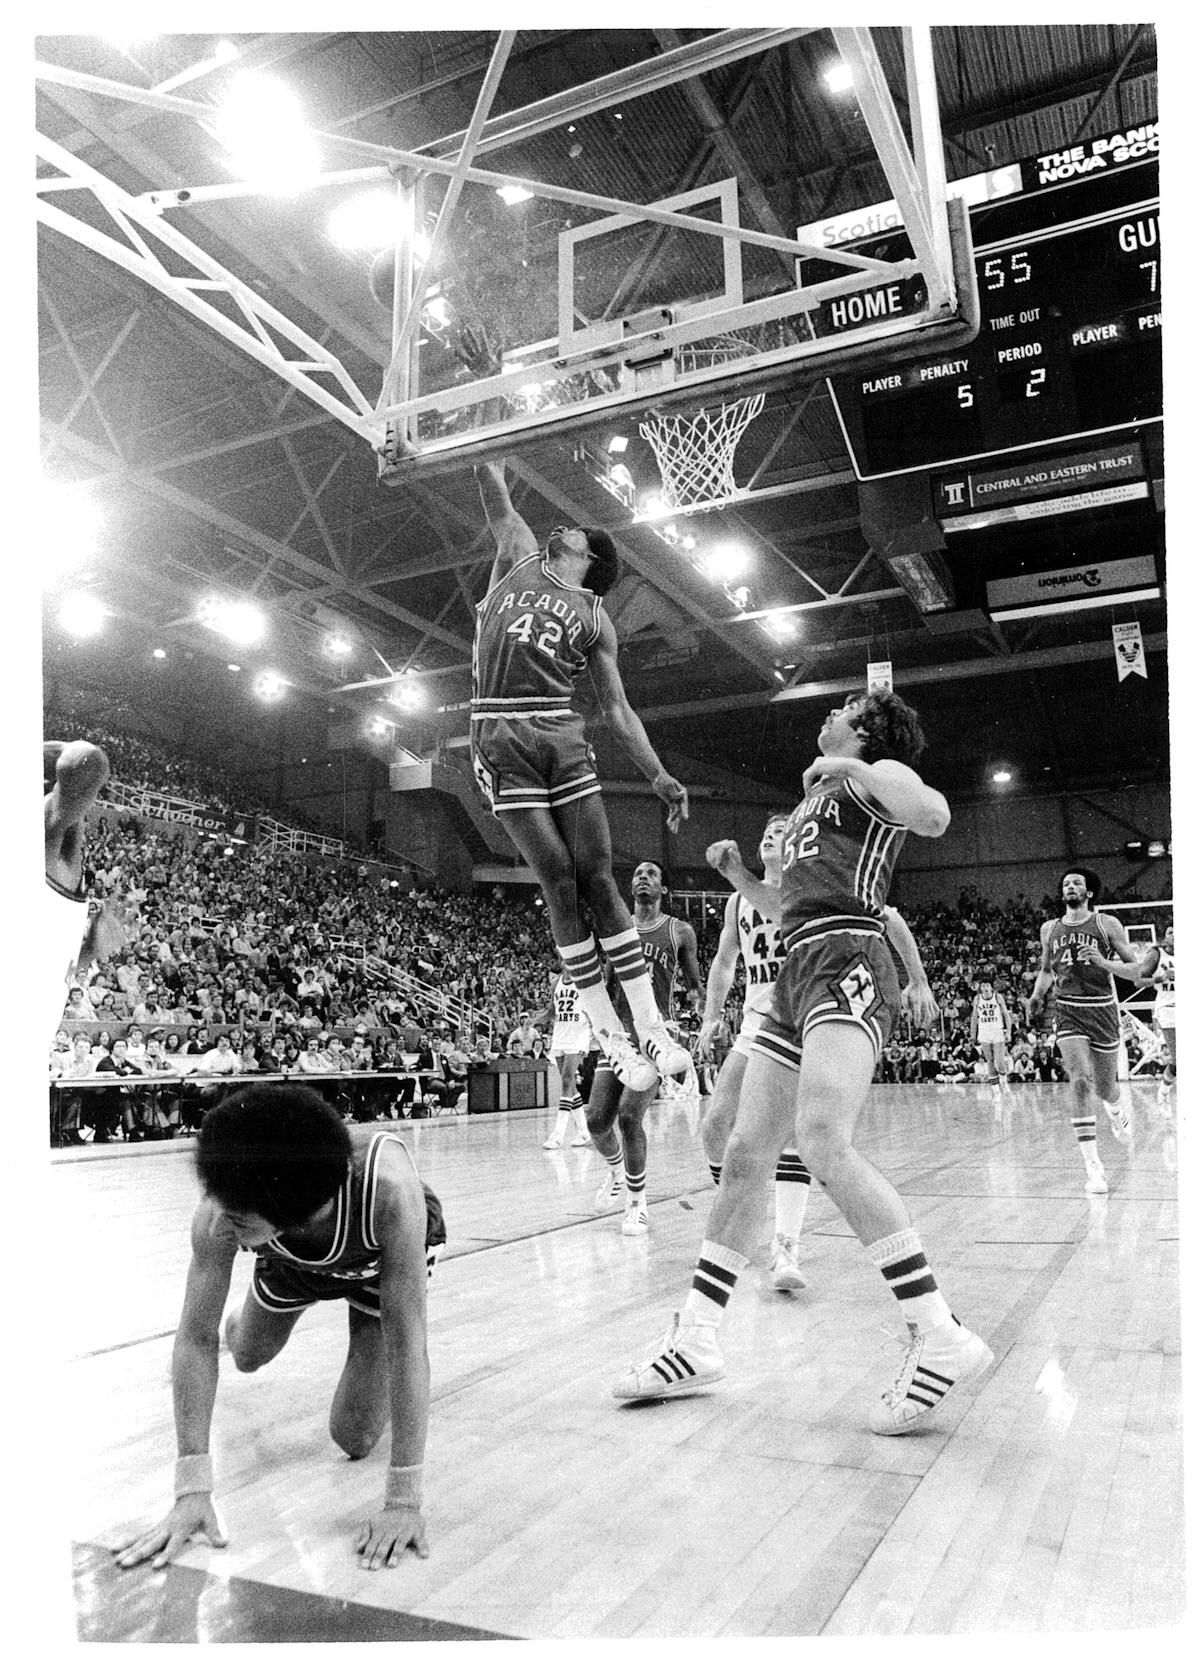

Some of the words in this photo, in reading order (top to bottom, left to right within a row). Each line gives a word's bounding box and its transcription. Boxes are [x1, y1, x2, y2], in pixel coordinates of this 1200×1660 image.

[1037, 146, 1085, 170] THE
[1092, 121, 1160, 155] BANK
[1039, 155, 1107, 184] NOVA
[823, 213, 898, 246] Scotia
[1118, 215, 1160, 252] GU
[985, 252, 1031, 290] 55
[831, 286, 902, 327] HOME
[989, 314, 1016, 331] TIME
[1020, 308, 1041, 323] OUT
[1072, 324, 1118, 346] PLAYER
[998, 343, 1042, 363] PERIOD
[862, 375, 902, 394] PLAYER
[920, 360, 969, 381] PENALTY
[1025, 368, 1046, 397] 2
[957, 384, 974, 408] 5
[976, 478, 1022, 494] CENTRAL
[1023, 472, 1048, 484] AND
[1050, 462, 1097, 480] EASTERN
[1098, 454, 1134, 471] TRUST
[1038, 569, 1101, 589] Dominion
[498, 591, 584, 646] ACADIA
[507, 613, 563, 658] 42
[782, 820, 820, 871] 52
[1053, 932, 1098, 954] ACADIA
[558, 1000, 574, 1012] 22
